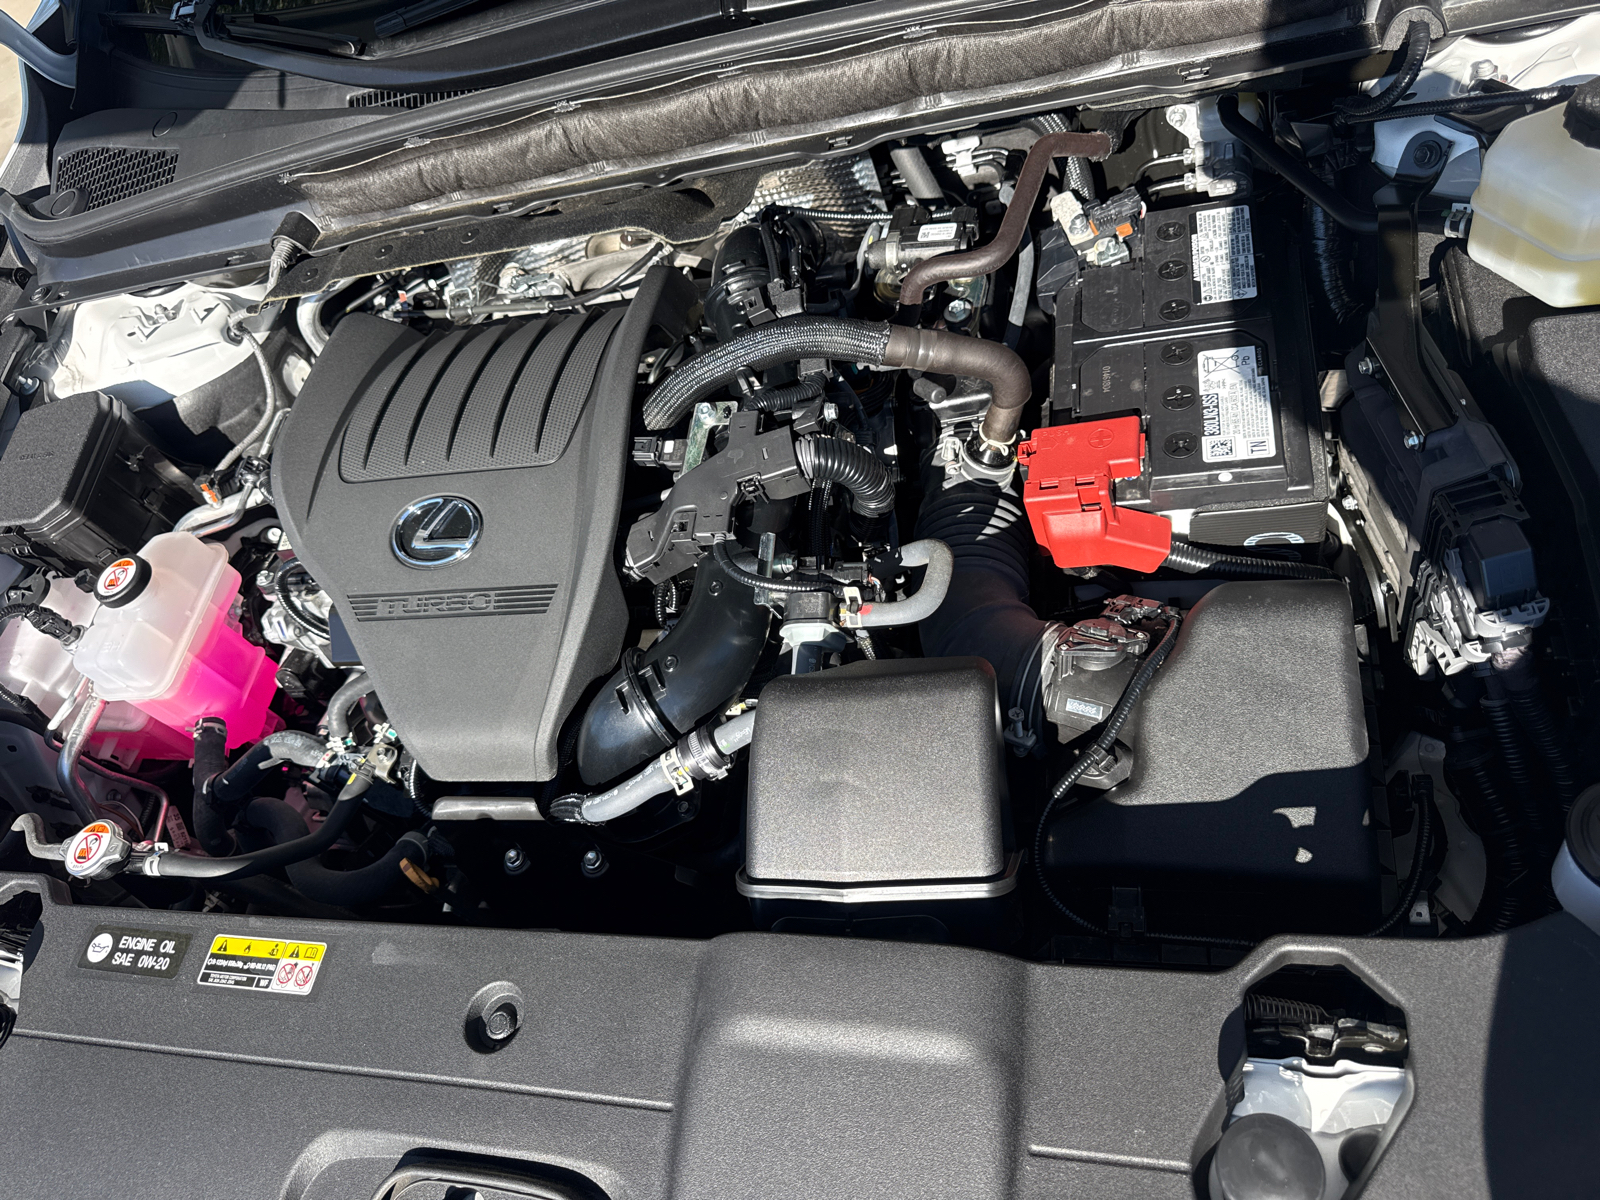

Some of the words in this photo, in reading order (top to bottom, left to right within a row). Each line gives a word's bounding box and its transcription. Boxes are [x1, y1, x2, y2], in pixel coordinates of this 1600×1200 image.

[1241, 355, 1250, 366] Pb
[1202, 394, 1220, 436] 380LN3-ISS
[1249, 440, 1267, 454] TN
[381, 592, 491, 615] TURBO
[118, 935, 157, 951] ENGINE
[160, 940, 176, 954] OIL
[111, 952, 135, 966] SAE
[137, 955, 170, 970] 0W-20
